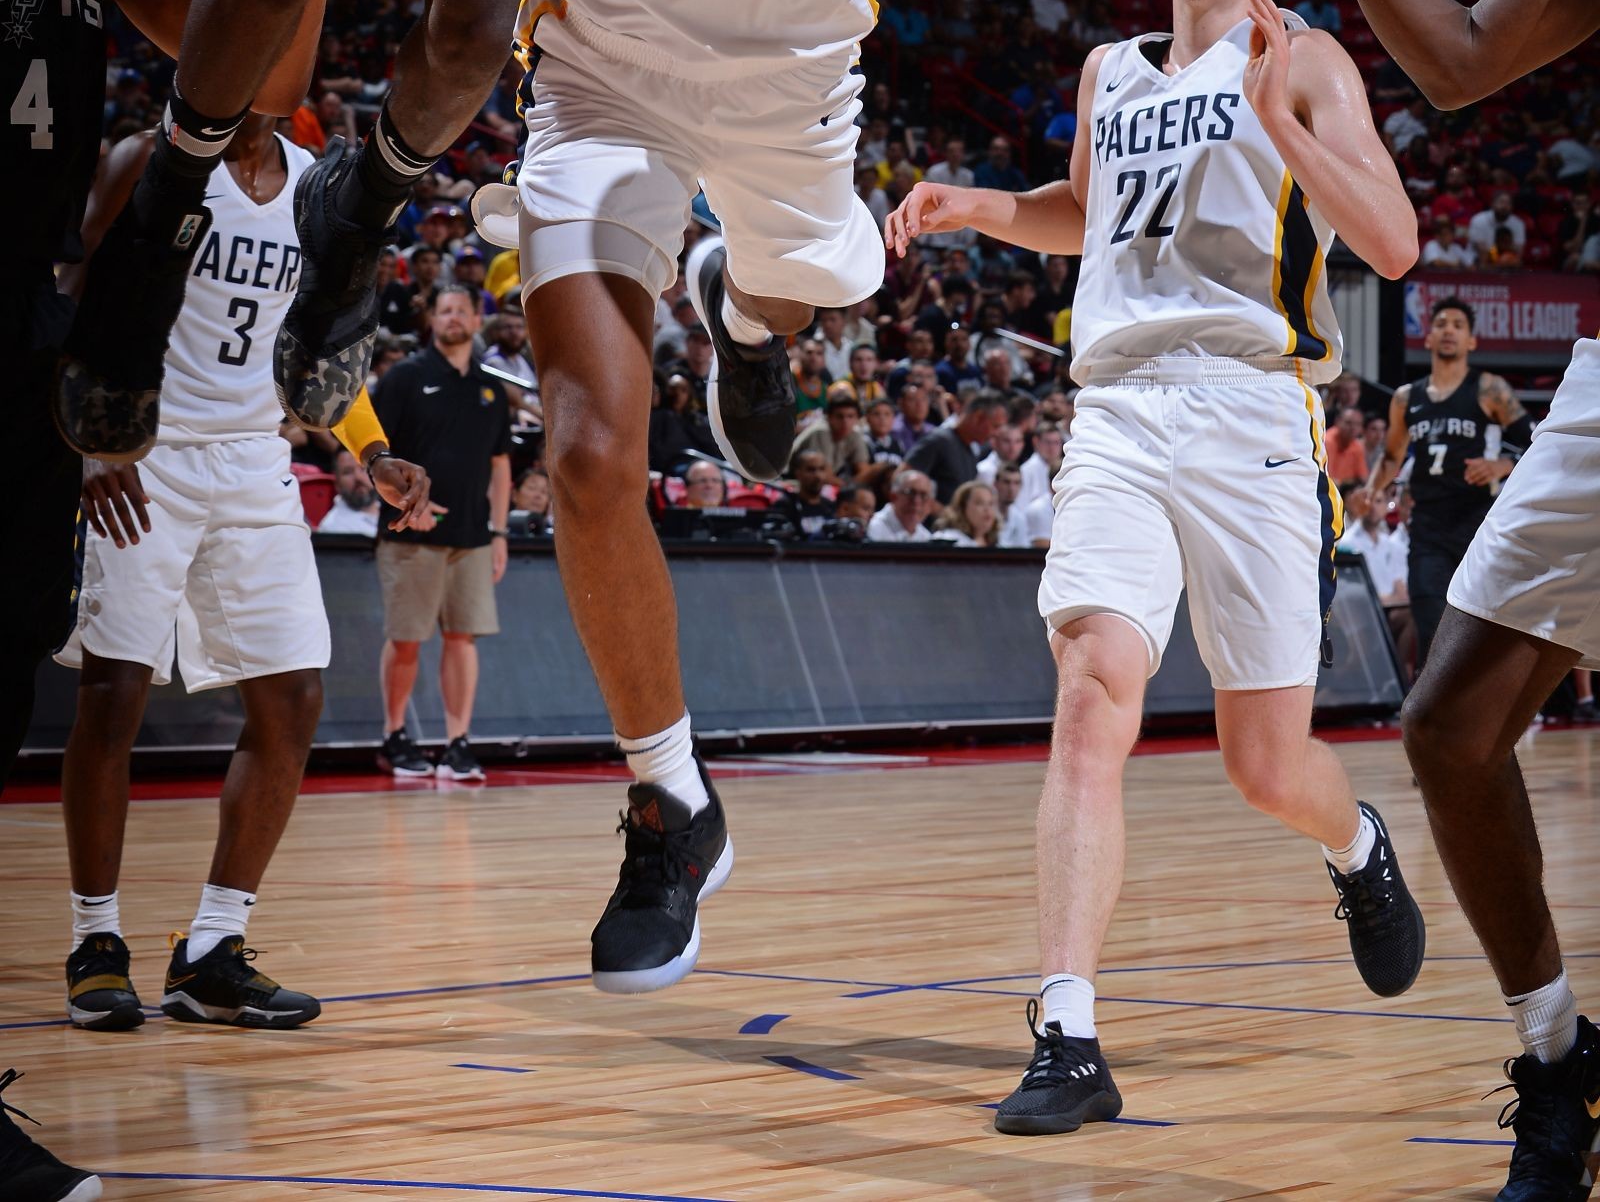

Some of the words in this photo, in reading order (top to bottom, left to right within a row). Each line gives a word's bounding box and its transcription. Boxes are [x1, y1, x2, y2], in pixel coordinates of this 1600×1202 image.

[10, 59, 54, 150] 4
[1095, 93, 1240, 171] PACERS
[1110, 162, 1182, 245] 22
[192, 230, 300, 293] ACER
[217, 297, 259, 367] 3
[1513, 302, 1581, 342] LEAGUE
[1408, 417, 1477, 441] SPURS
[1428, 443, 1448, 476] 7
